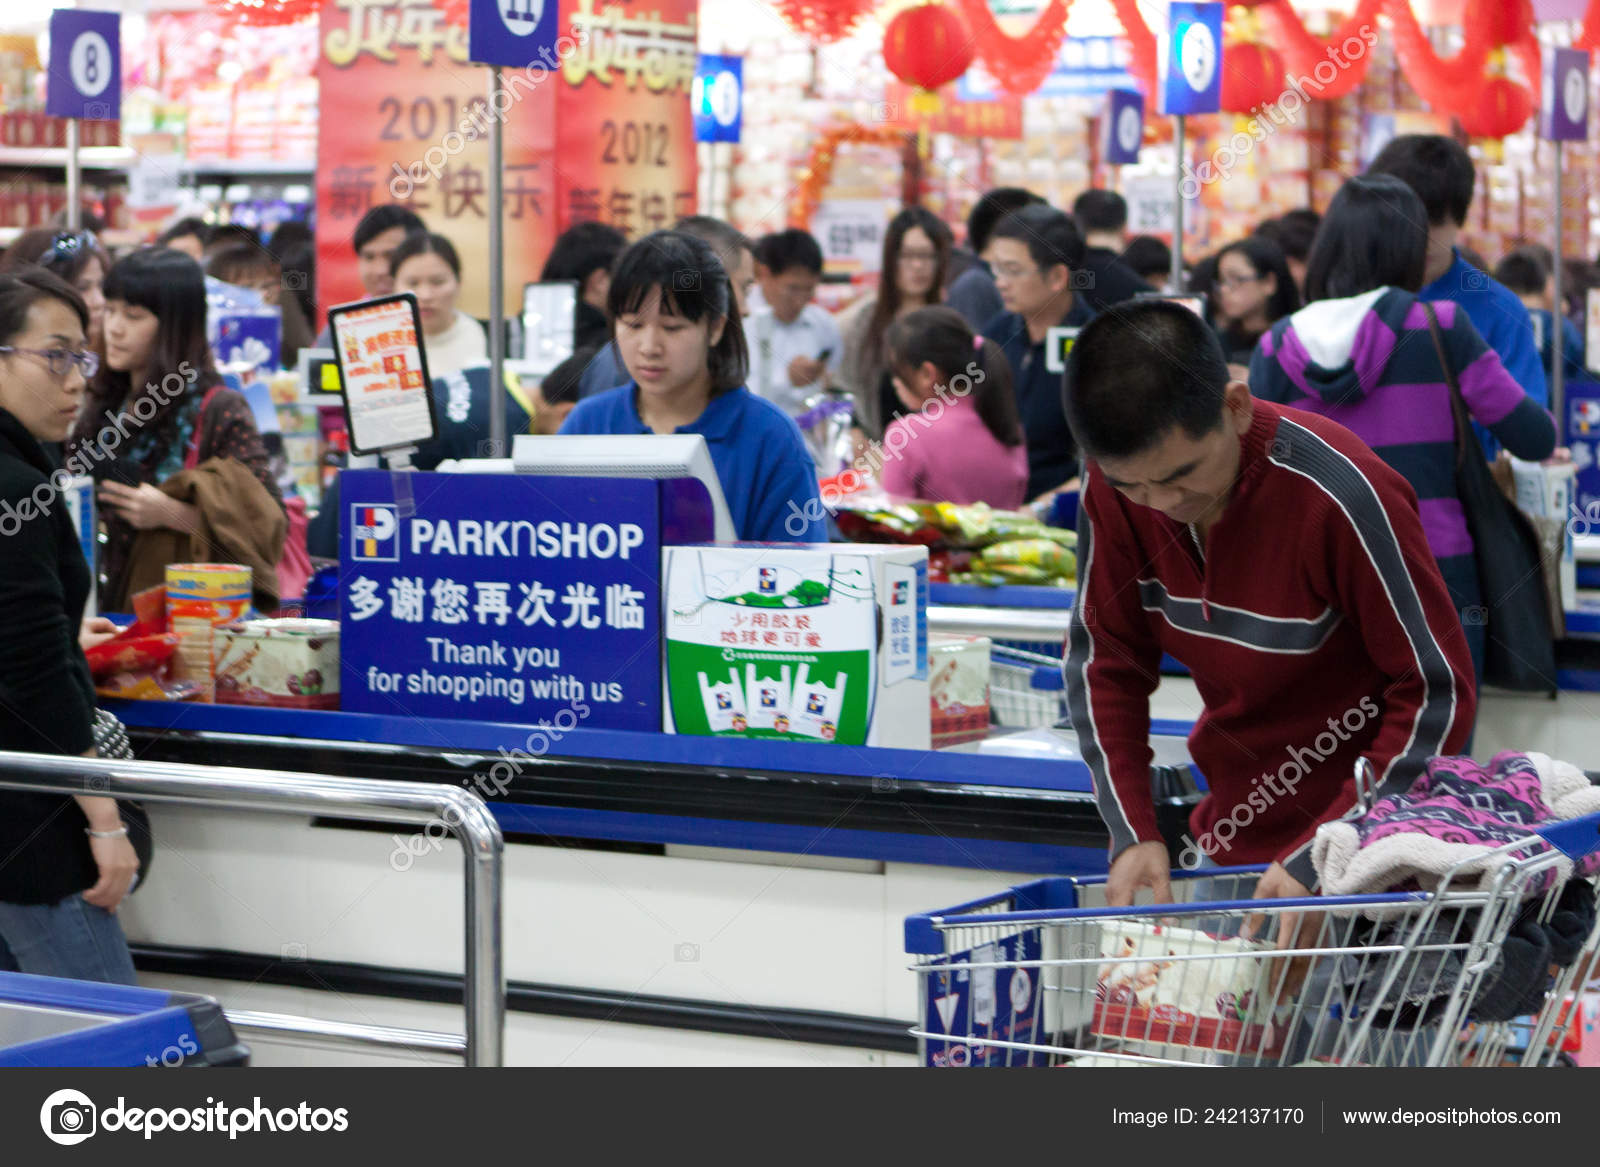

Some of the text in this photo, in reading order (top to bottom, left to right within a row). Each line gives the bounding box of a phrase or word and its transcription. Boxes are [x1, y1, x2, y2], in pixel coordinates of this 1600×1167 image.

[84, 43, 98, 84] 8
[601, 121, 670, 166] 2012
[349, 575, 645, 630] 多谢您再次光临
[426, 637, 560, 672] Thank you
[367, 666, 623, 704] for shopping with us
